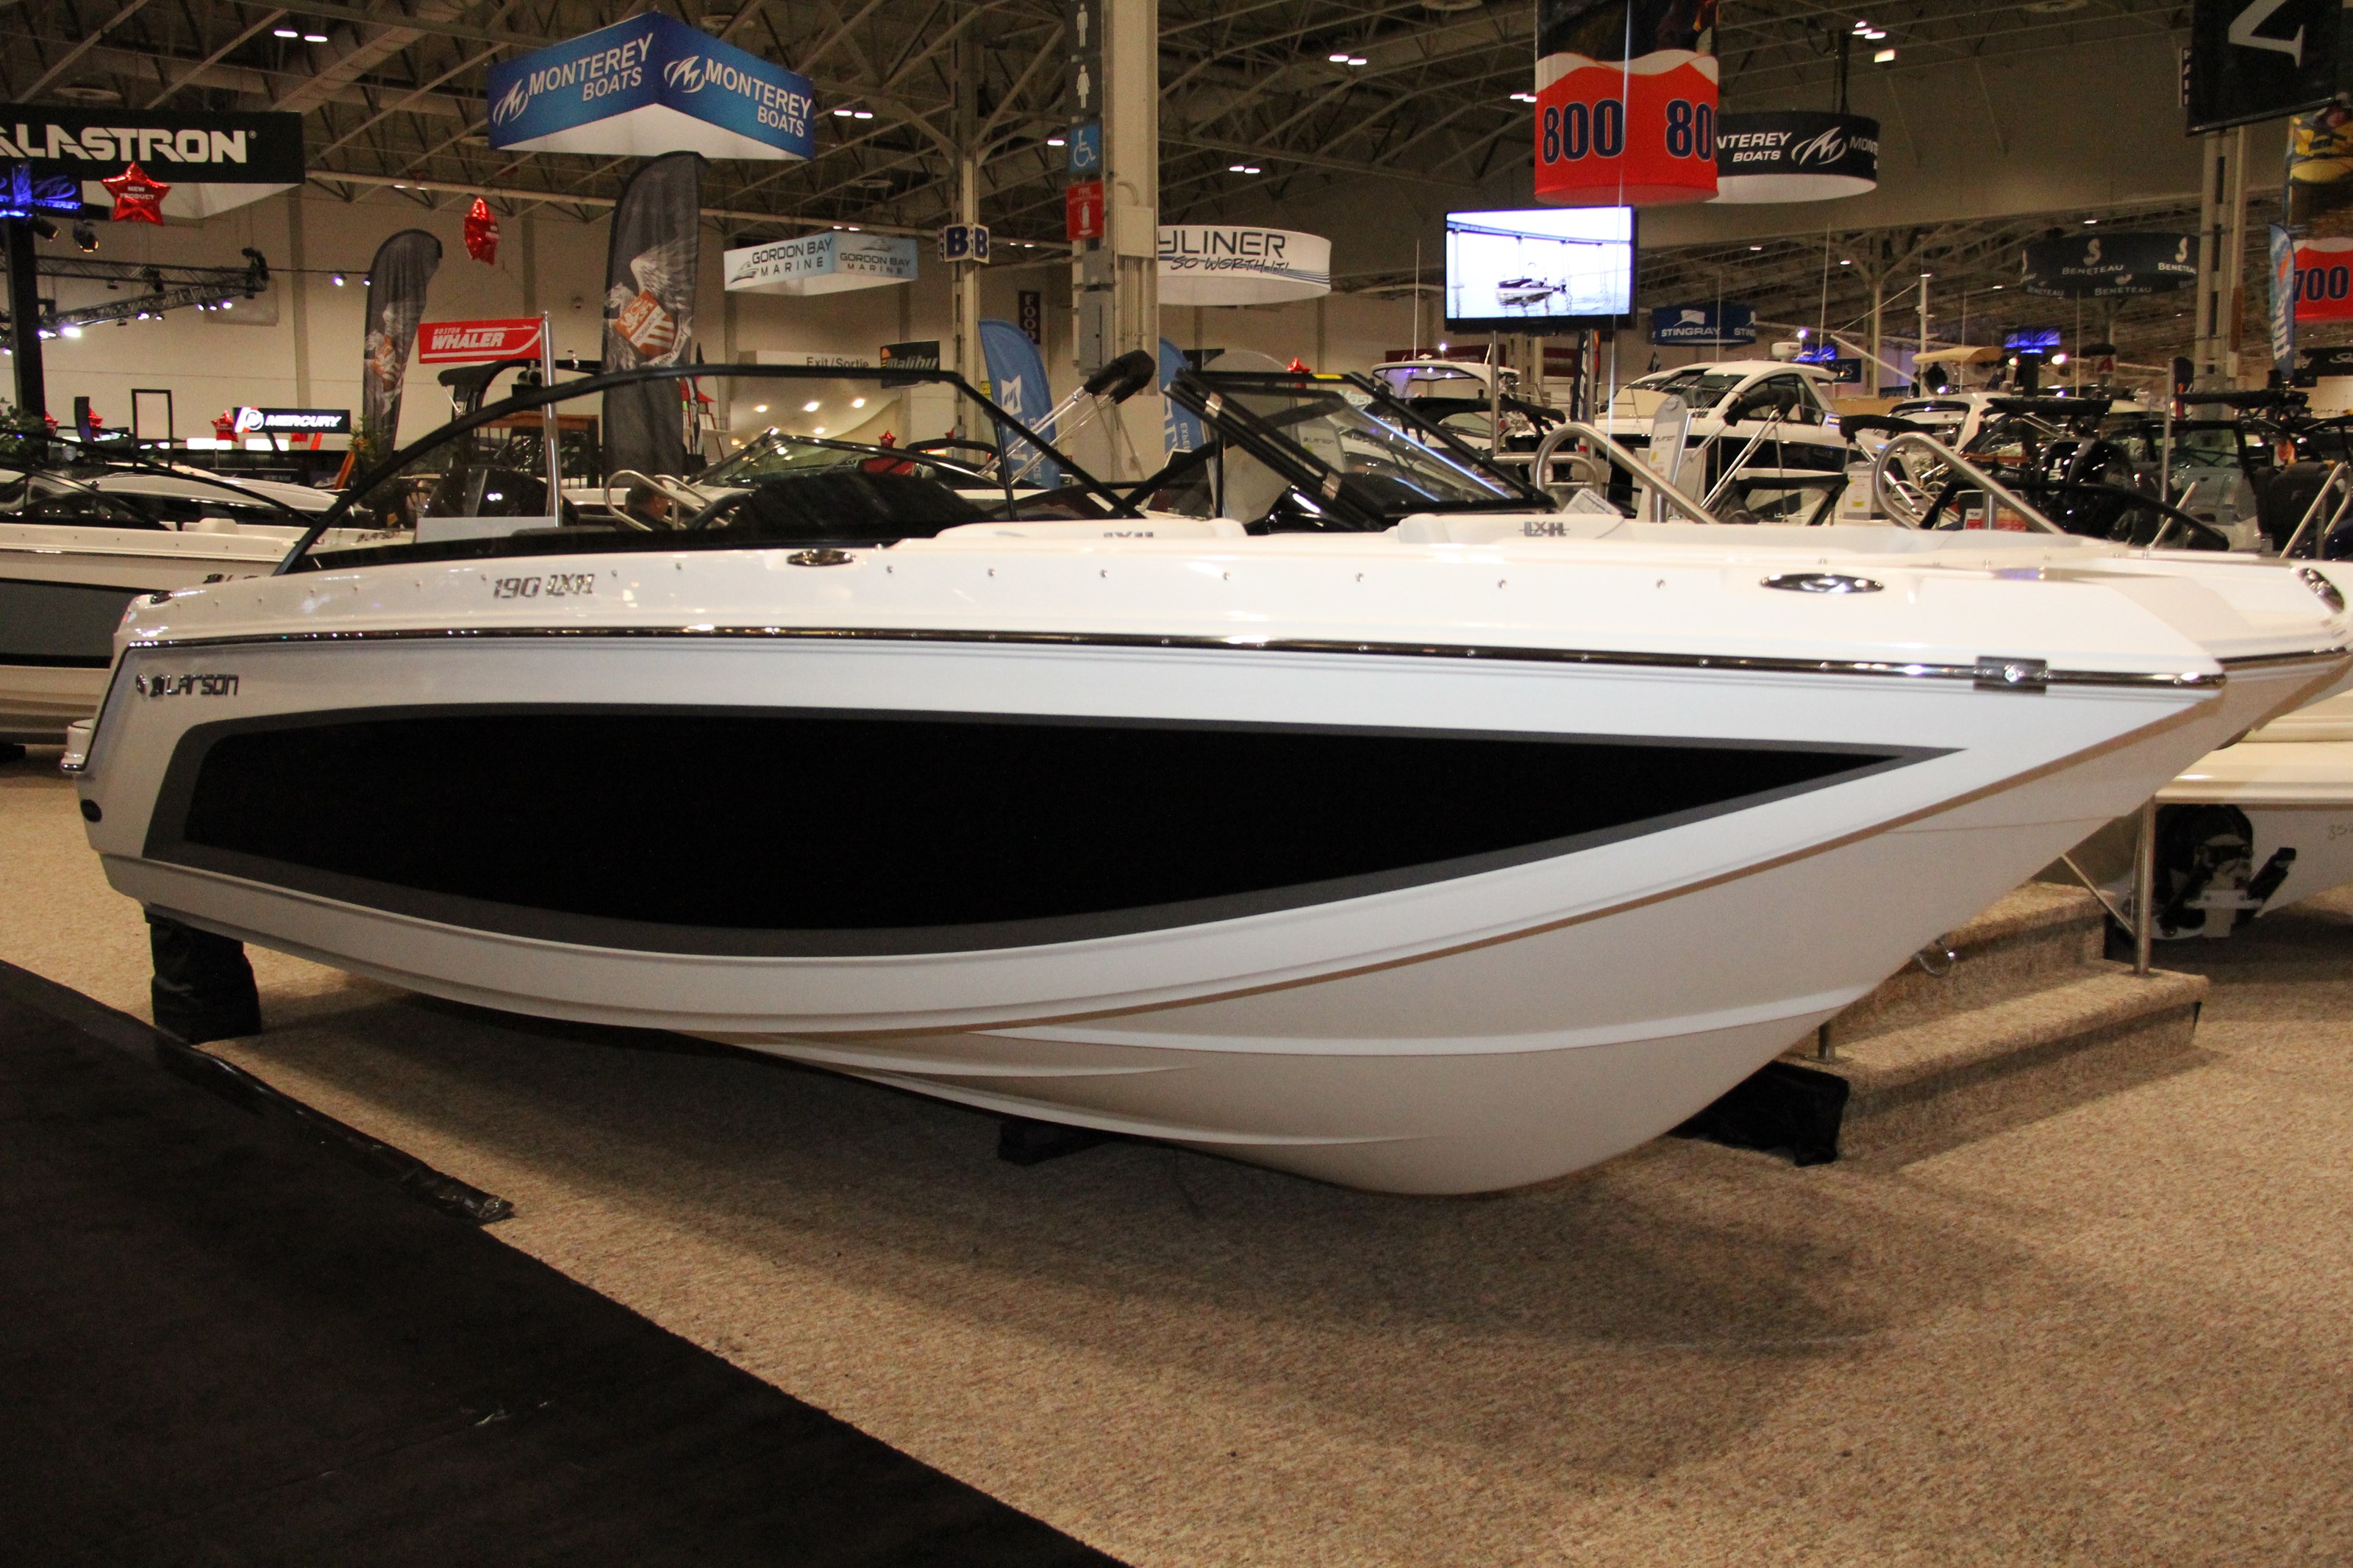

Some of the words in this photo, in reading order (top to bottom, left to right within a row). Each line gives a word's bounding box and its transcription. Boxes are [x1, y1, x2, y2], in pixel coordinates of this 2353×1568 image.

[529, 33, 654, 96] MONTEREY
[582, 67, 643, 101] BOATS
[704, 59, 812, 119] MONTEREY
[757, 105, 804, 137] BOATS
[1542, 99, 1626, 165] 800
[1665, 99, 1718, 165] 80
[1732, 150, 1782, 162] BOATS
[752, 243, 804, 264] GORDON
[808, 237, 832, 254] BAY
[946, 226, 968, 258] B
[974, 227, 988, 259] B
[760, 257, 824, 276] MARINE
[840, 253, 887, 264] GORDON
[890, 257, 910, 267] BAY
[847, 262, 903, 275] MARINE
[1171, 255, 1199, 271] SO
[1204, 257, 1266, 273] WORTH
[2062, 265, 2124, 276] BENETEAU
[2095, 286, 2152, 296] BENETEAU
[434, 327, 461, 335] BOSTON
[1661, 327, 1721, 337] STINGRAY
[431, 332, 505, 350] WHALER
[265, 415, 342, 428] MERCURY
[493, 577, 541, 598] 190
